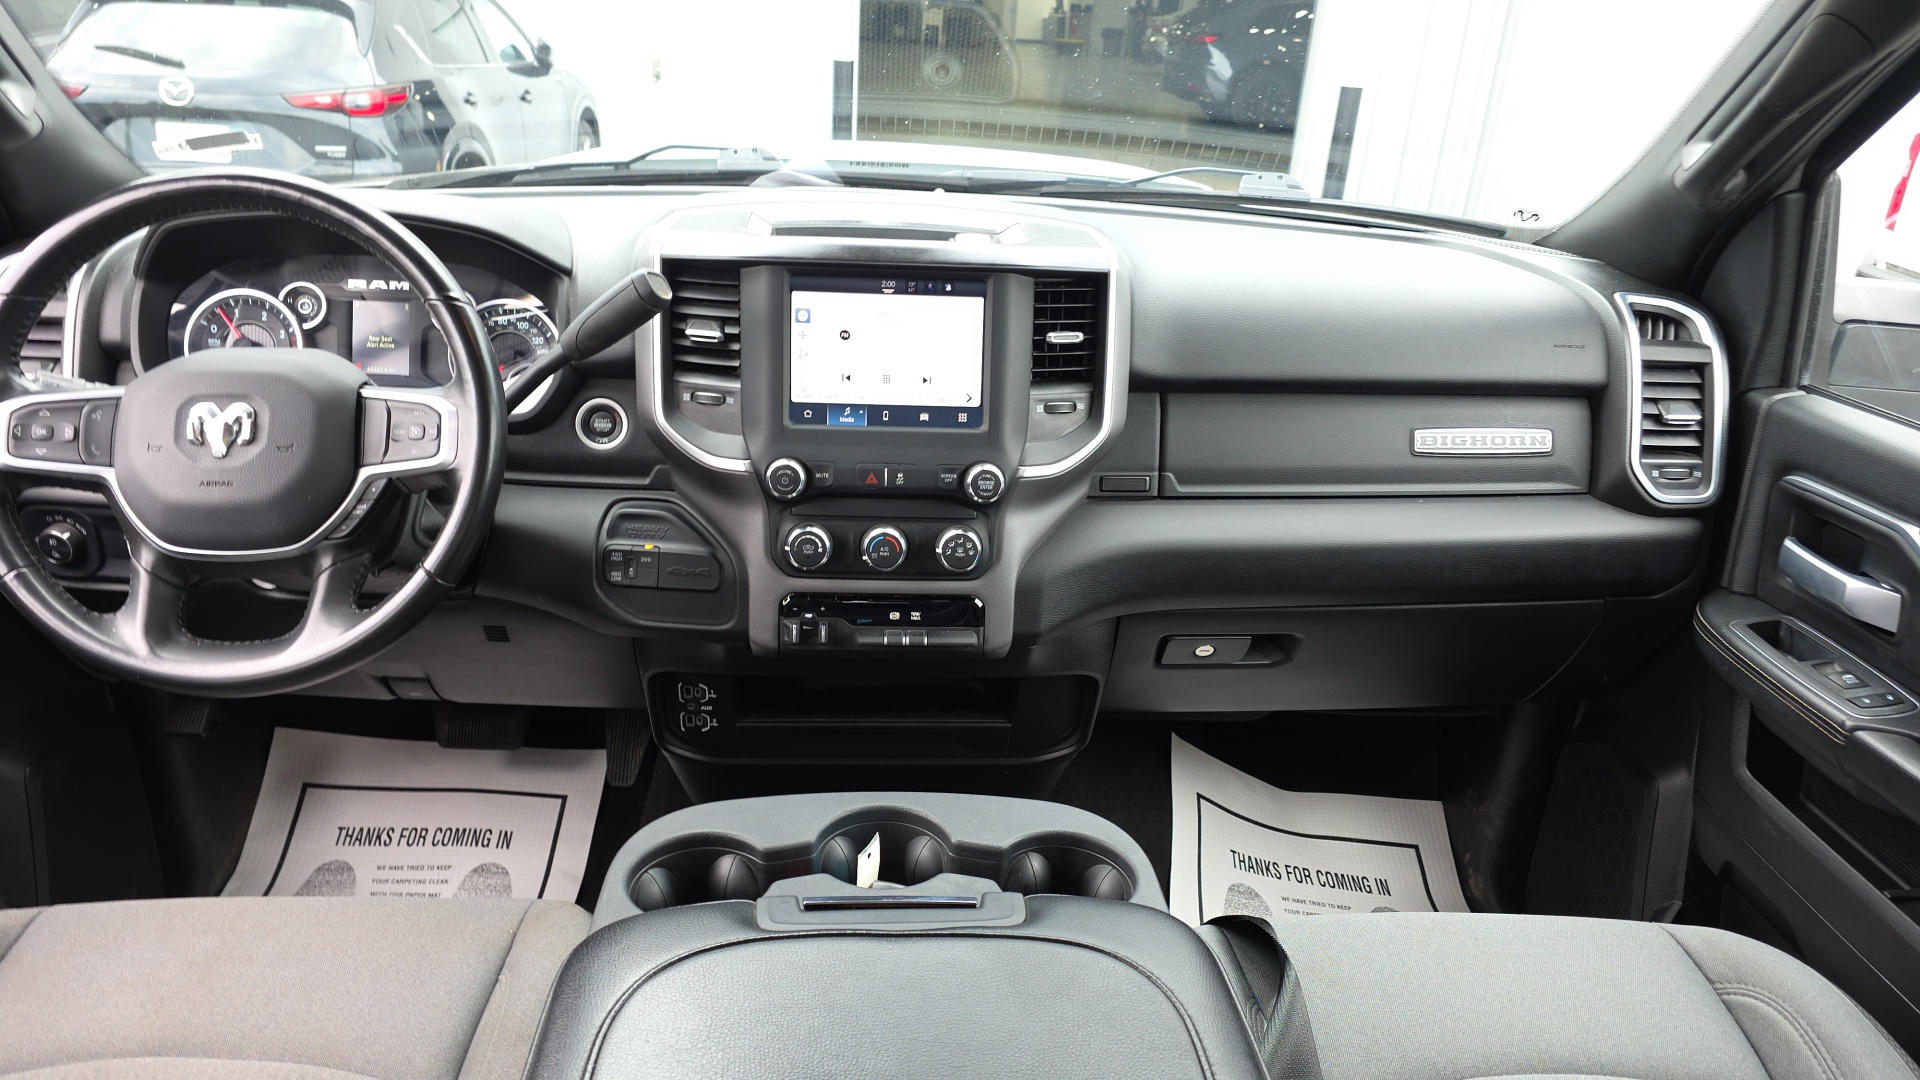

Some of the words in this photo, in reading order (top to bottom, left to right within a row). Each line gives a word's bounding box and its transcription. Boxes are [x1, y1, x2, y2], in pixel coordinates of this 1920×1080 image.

[347, 279, 410, 290] RAM
[233, 308, 239, 318] 1
[261, 311, 267, 321] 2
[210, 324, 218, 333] 0
[516, 321, 529, 330] 100
[279, 330, 285, 339] 3
[532, 337, 544, 345] 120
[36, 428, 47, 436] OK
[1419, 436, 1548, 447] BIGHORN
[625, 524, 670, 534] HEAVY
[629, 531, 666, 540] DUTY
[335, 826, 395, 847] THANKS
[397, 827, 429, 848] FOR
[431, 827, 493, 849] COMING
[495, 830, 514, 850] IN
[1230, 849, 1283, 881] THANKS
[1284, 864, 1315, 886] FOR
[1316, 869, 1374, 895] COMING
[1374, 877, 1392, 897] IN
[1291, 897, 1308, 905] HAVE
[1309, 900, 1327, 908] TRIED
[1283, 908, 1300, 916] YOUR
